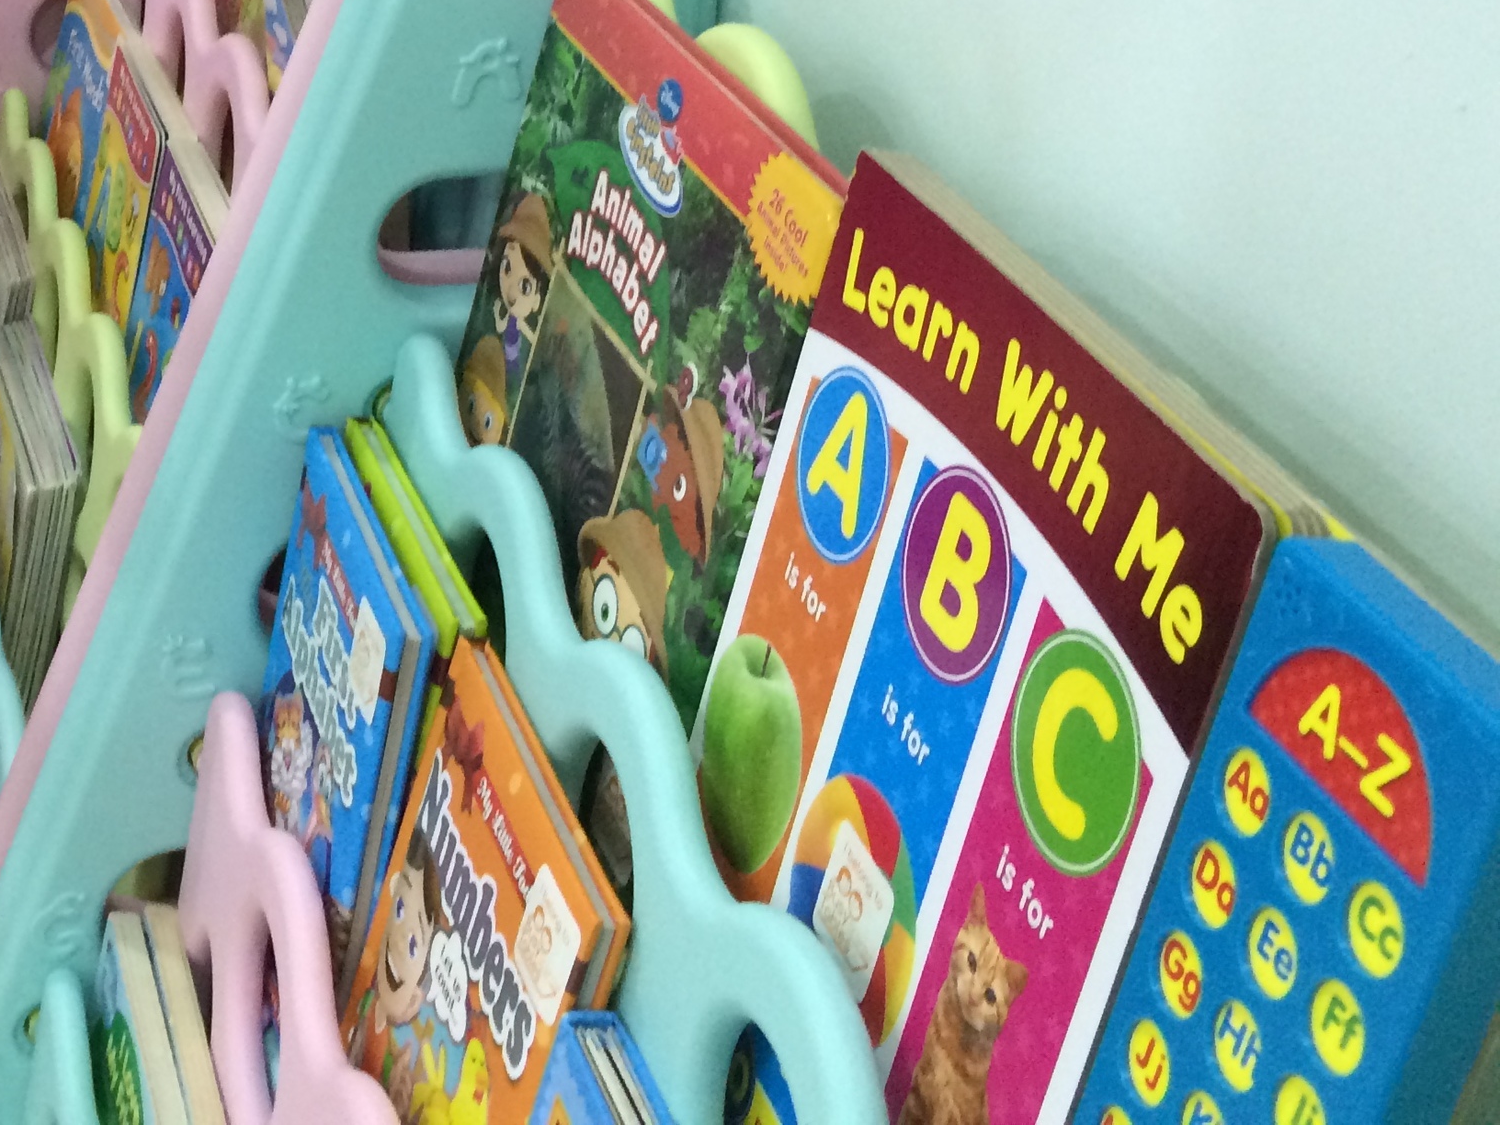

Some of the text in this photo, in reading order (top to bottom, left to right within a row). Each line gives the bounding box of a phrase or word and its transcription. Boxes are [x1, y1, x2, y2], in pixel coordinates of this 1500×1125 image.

[590, 167, 667, 284] Animal
[768, 188, 809, 249] 26 Cool
[567, 210, 660, 355] Alphabet
[805, 390, 869, 542] A
[841, 227, 1203, 666] Learn With Me
[784, 551, 827, 623] is for
[919, 490, 992, 653] B
[281, 573, 358, 809] Alphabet
[311, 574, 357, 731] First
[881, 683, 931, 767] is for
[1031, 666, 1119, 842] C
[476, 774, 493, 822] My
[1226, 760, 1270, 823] Aa
[996, 844, 1055, 940] is for
[1288, 824, 1332, 888] Bb
[418, 749, 535, 1078] Numbers
[1256, 919, 1294, 982] Ee
[1357, 894, 1401, 962] Cc
[1162, 938, 1202, 1013] Gg
[1135, 1036, 1167, 1091] Jj
[1321, 995, 1364, 1052] Ff
